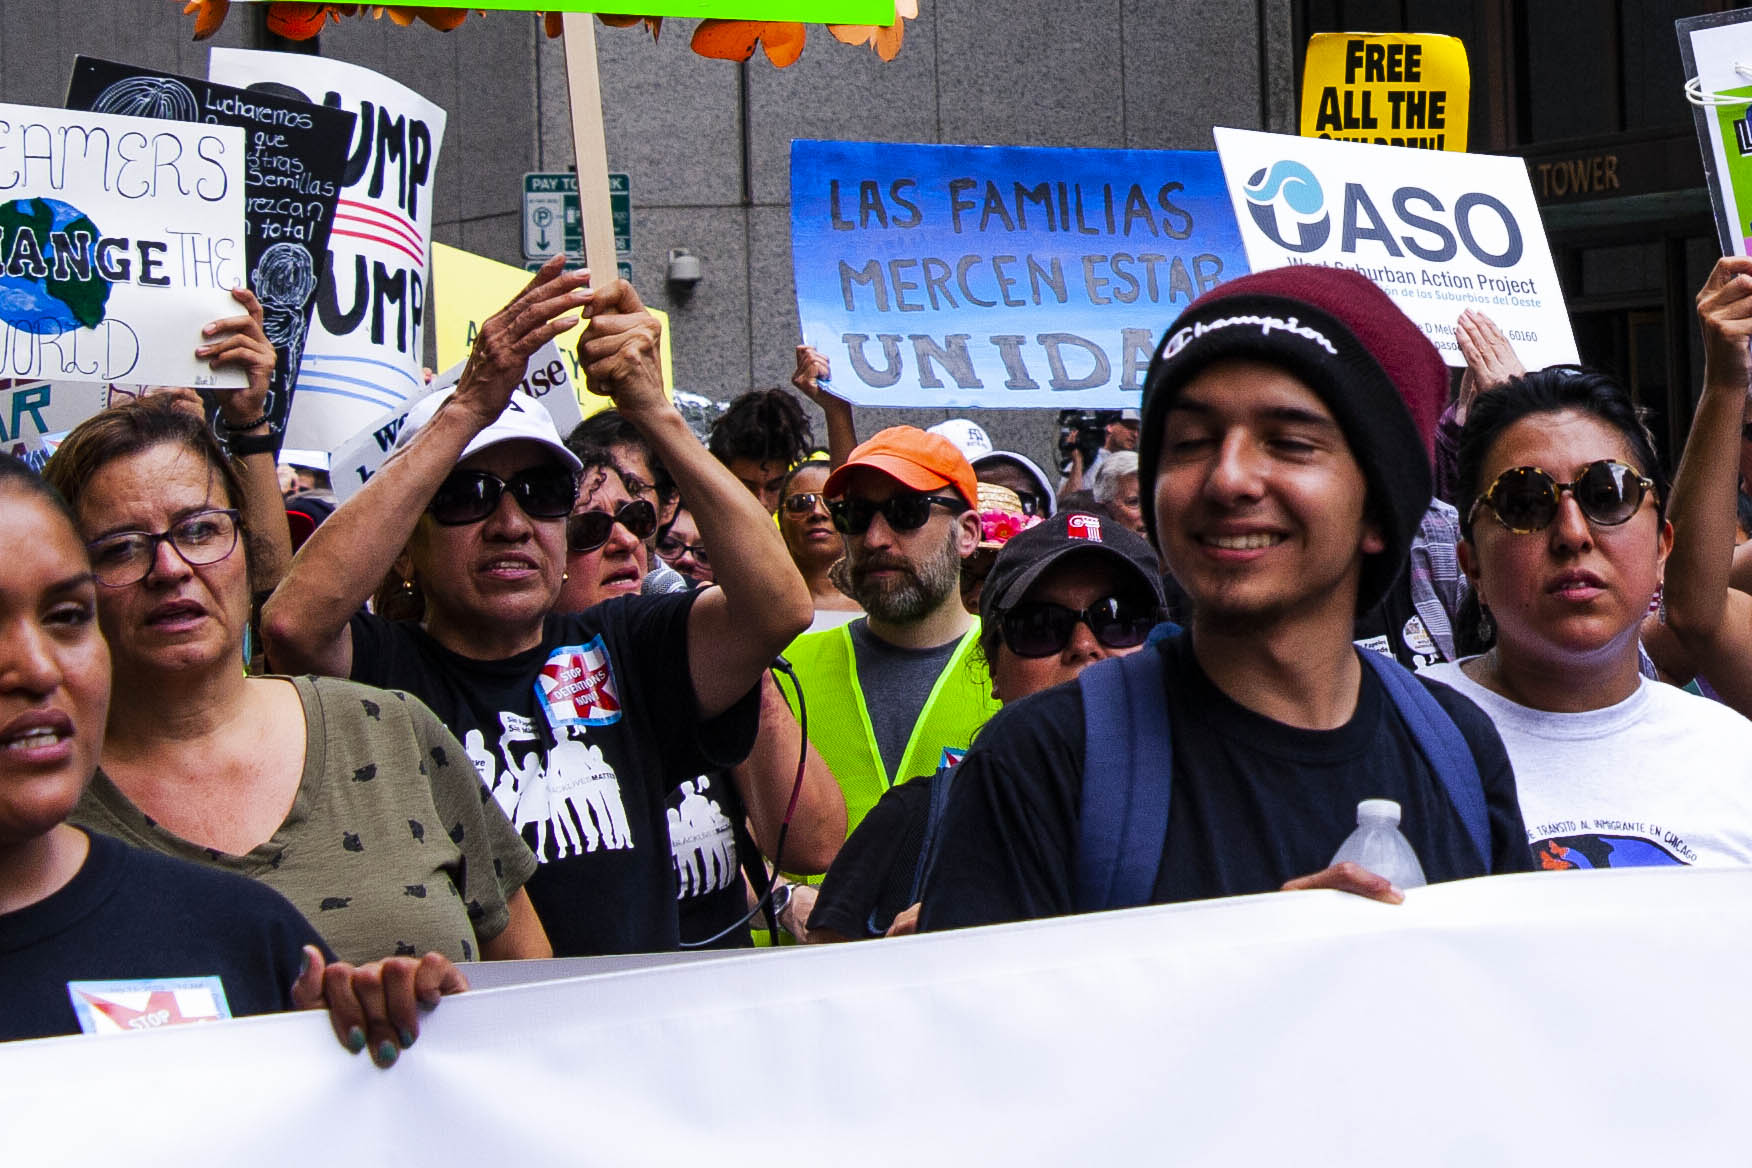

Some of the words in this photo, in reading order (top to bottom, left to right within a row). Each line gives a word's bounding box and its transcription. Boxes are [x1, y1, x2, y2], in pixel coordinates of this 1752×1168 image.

[1345, 40, 1422, 84] FREE
[206, 88, 313, 129] Lucharemos
[1315, 86, 1378, 131] ALL
[1387, 90, 1447, 130] THE
[254, 131, 289, 157] que
[285, 81, 432, 222] UMP
[532, 177, 558, 190] PAY
[1538, 155, 1620, 198] TOWER
[830, 177, 923, 232] LAS
[949, 176, 1194, 241] FAMILIAS
[261, 218, 316, 242] total
[0, 225, 170, 287] ANGE
[165, 226, 241, 291] THE
[838, 252, 1068, 313] MERCEN
[1401, 287, 1414, 298] de
[1417, 288, 1433, 299] los
[1435, 290, 1490, 304] Suburbios
[1493, 295, 1509, 306] del
[1511, 296, 1542, 308] Oeste
[1422, 269, 1474, 290] Action
[1477, 273, 1538, 296] Project
[314, 248, 424, 360] UMP
[1162, 316, 1338, 359] Champion
[1509, 330, 1538, 343] 60160
[842, 327, 1156, 392] UNIDA
[554, 669, 607, 700] DETENTIONS
[560, 666, 582, 682] STOP
[575, 690, 600, 706] NOW!
[1580, 819, 1590, 831] AL
[1593, 818, 1646, 833] INMIGRANTE
[1649, 823, 1662, 837] EN
[1663, 830, 1698, 863] CHICAGO
[127, 1009, 170, 1031] STOP
